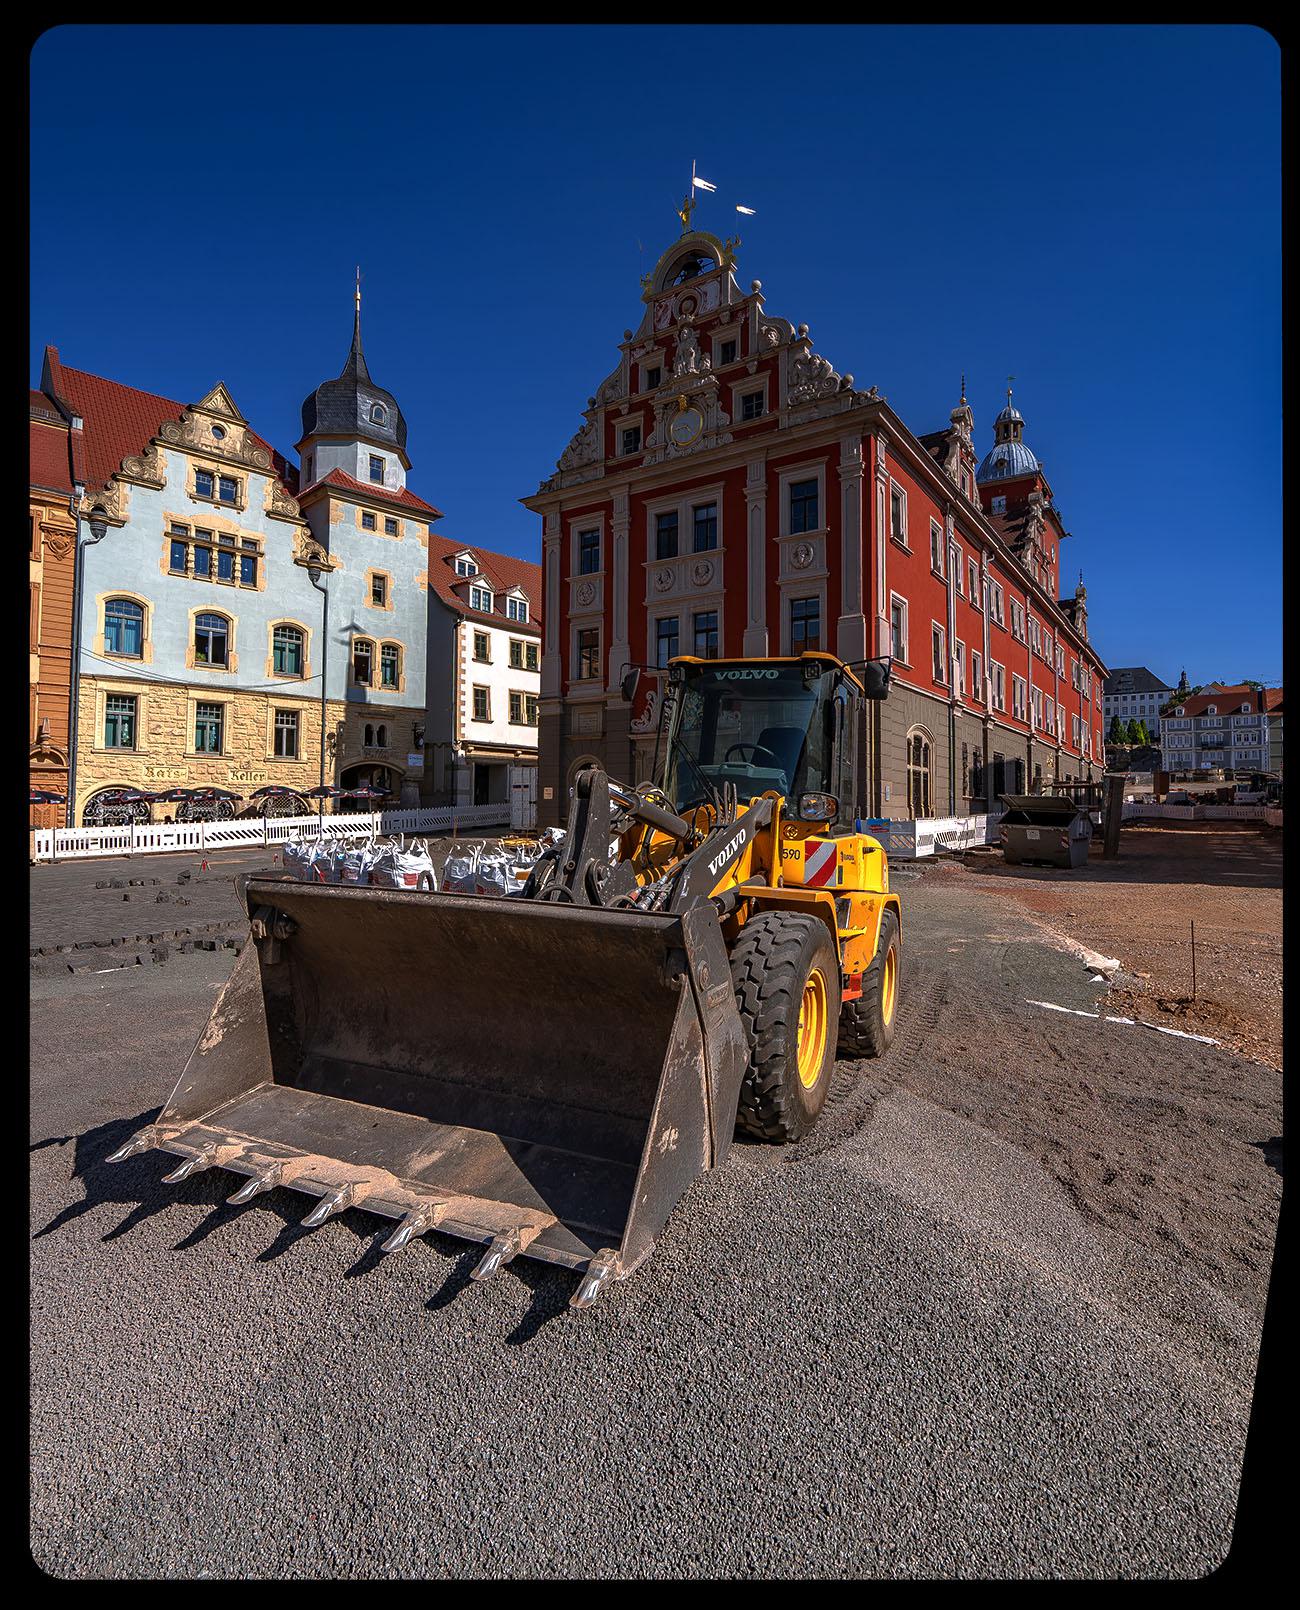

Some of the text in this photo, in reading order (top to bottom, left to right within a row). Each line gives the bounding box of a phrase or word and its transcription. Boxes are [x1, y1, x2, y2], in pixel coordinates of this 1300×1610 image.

[714, 670, 779, 680] VOLVO
[230, 769, 265, 781] Keller
[708, 828, 747, 876] VOLVO
